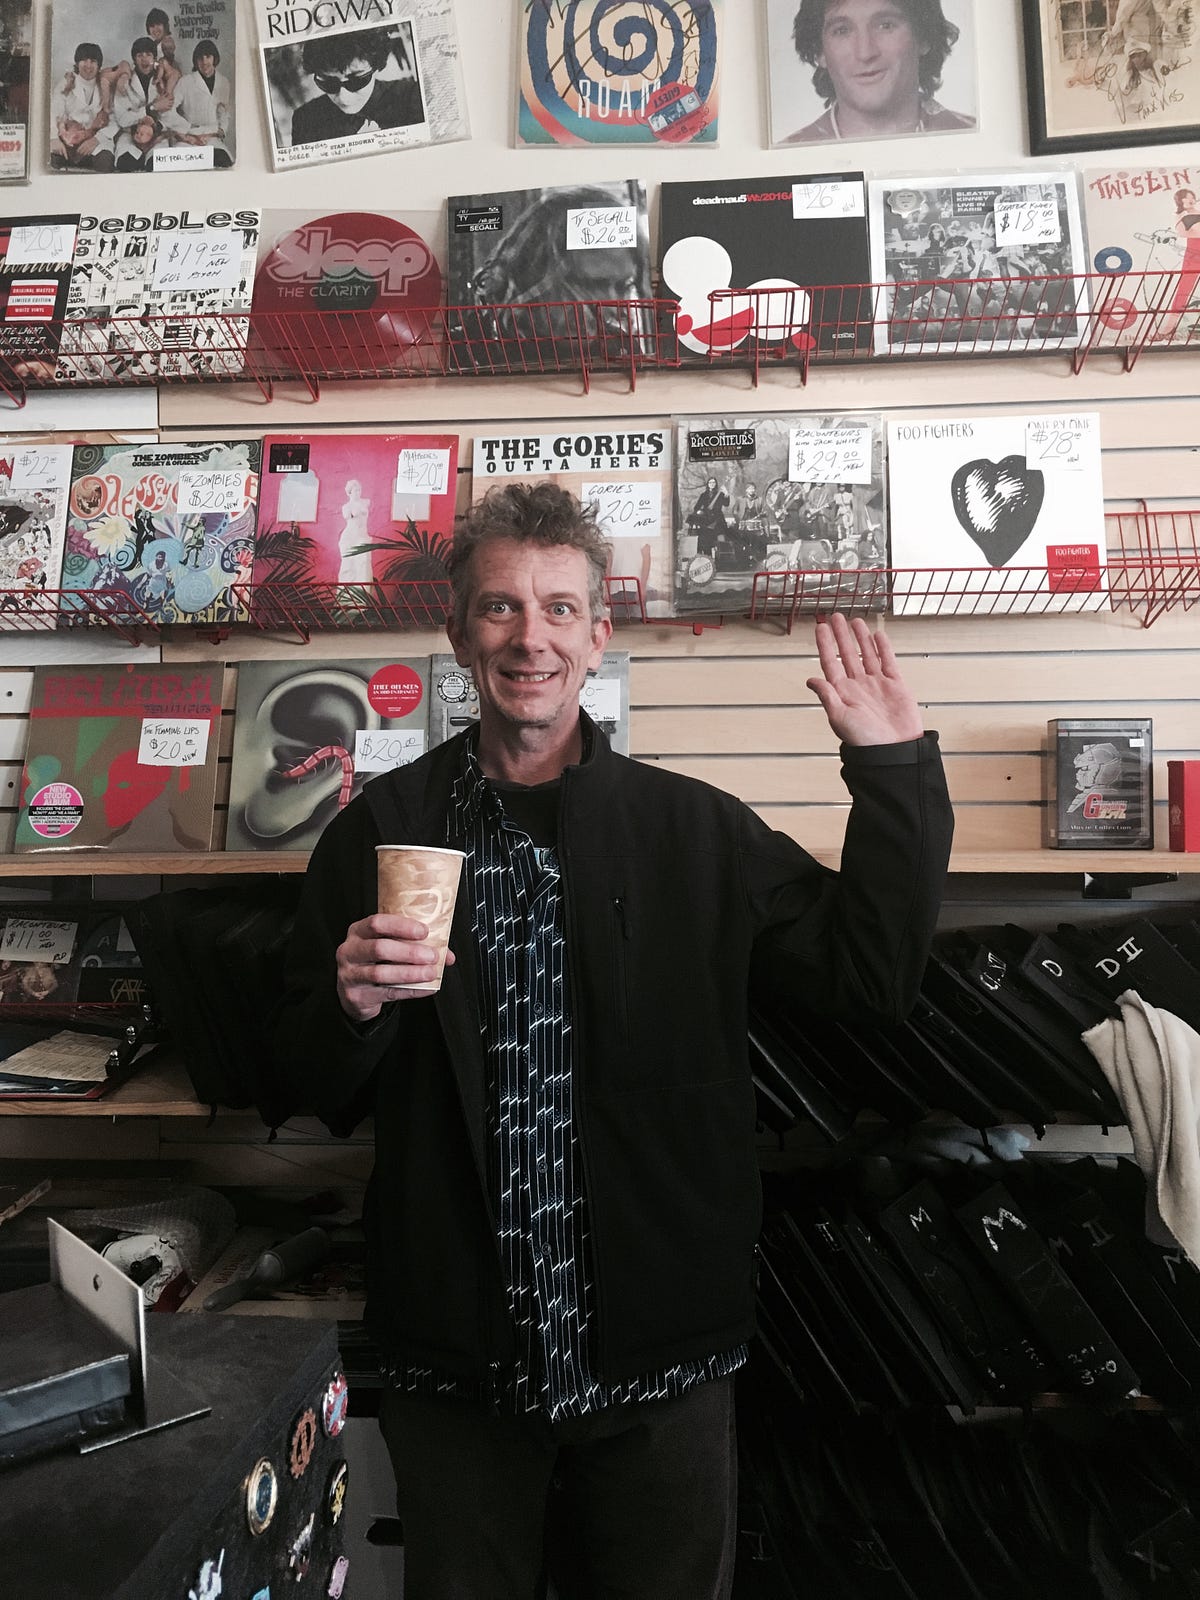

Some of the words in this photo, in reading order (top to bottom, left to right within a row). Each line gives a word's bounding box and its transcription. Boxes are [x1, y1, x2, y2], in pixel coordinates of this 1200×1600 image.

[266, 0, 394, 38] RIDGWAY
[586, 210, 632, 227] SEGALL
[470, 224, 499, 232] SEGALL
[277, 287, 305, 298] THE
[310, 285, 372, 298] CLARITY
[795, 430, 861, 442] RACONTEURS
[897, 426, 921, 441] FOO
[924, 423, 974, 439] FIGHTERS
[482, 438, 541, 461] THE
[553, 433, 664, 459] GORIES
[691, 434, 754, 448] RACONTEURS
[132, 460, 166, 468] ODESSEY
[133, 454, 153, 462] THE
[154, 452, 202, 462] ZOMBIES
[486, 459, 570, 473] OUTTA
[590, 456, 659, 470] HERE
[191, 473, 242, 489] ZOMBIES
[588, 484, 634, 497] GORIES
[1095, 957, 1121, 980] D
